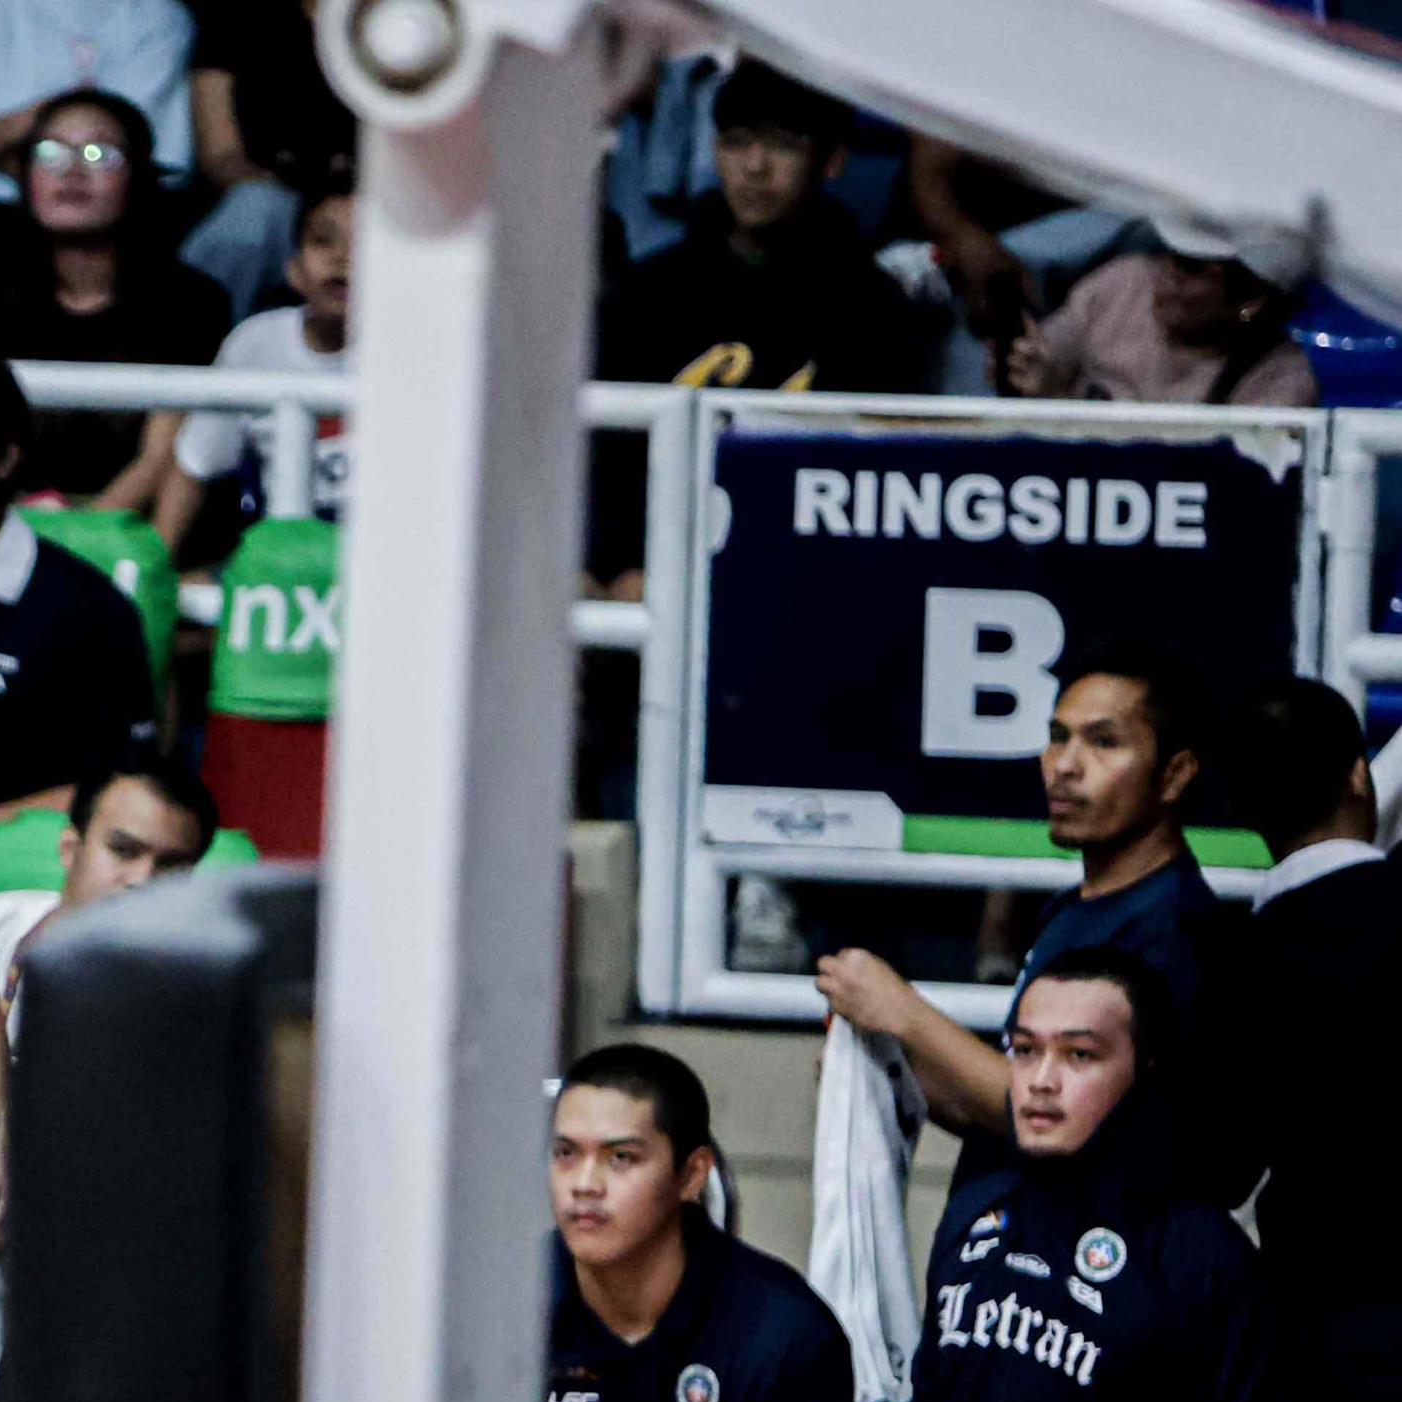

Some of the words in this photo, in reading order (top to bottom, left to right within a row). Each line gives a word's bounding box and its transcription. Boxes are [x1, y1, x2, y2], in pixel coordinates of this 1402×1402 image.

[795, 468, 1208, 548] RINGSIDE
[920, 586, 1065, 758] B
[937, 1281, 1102, 1387] Letran
